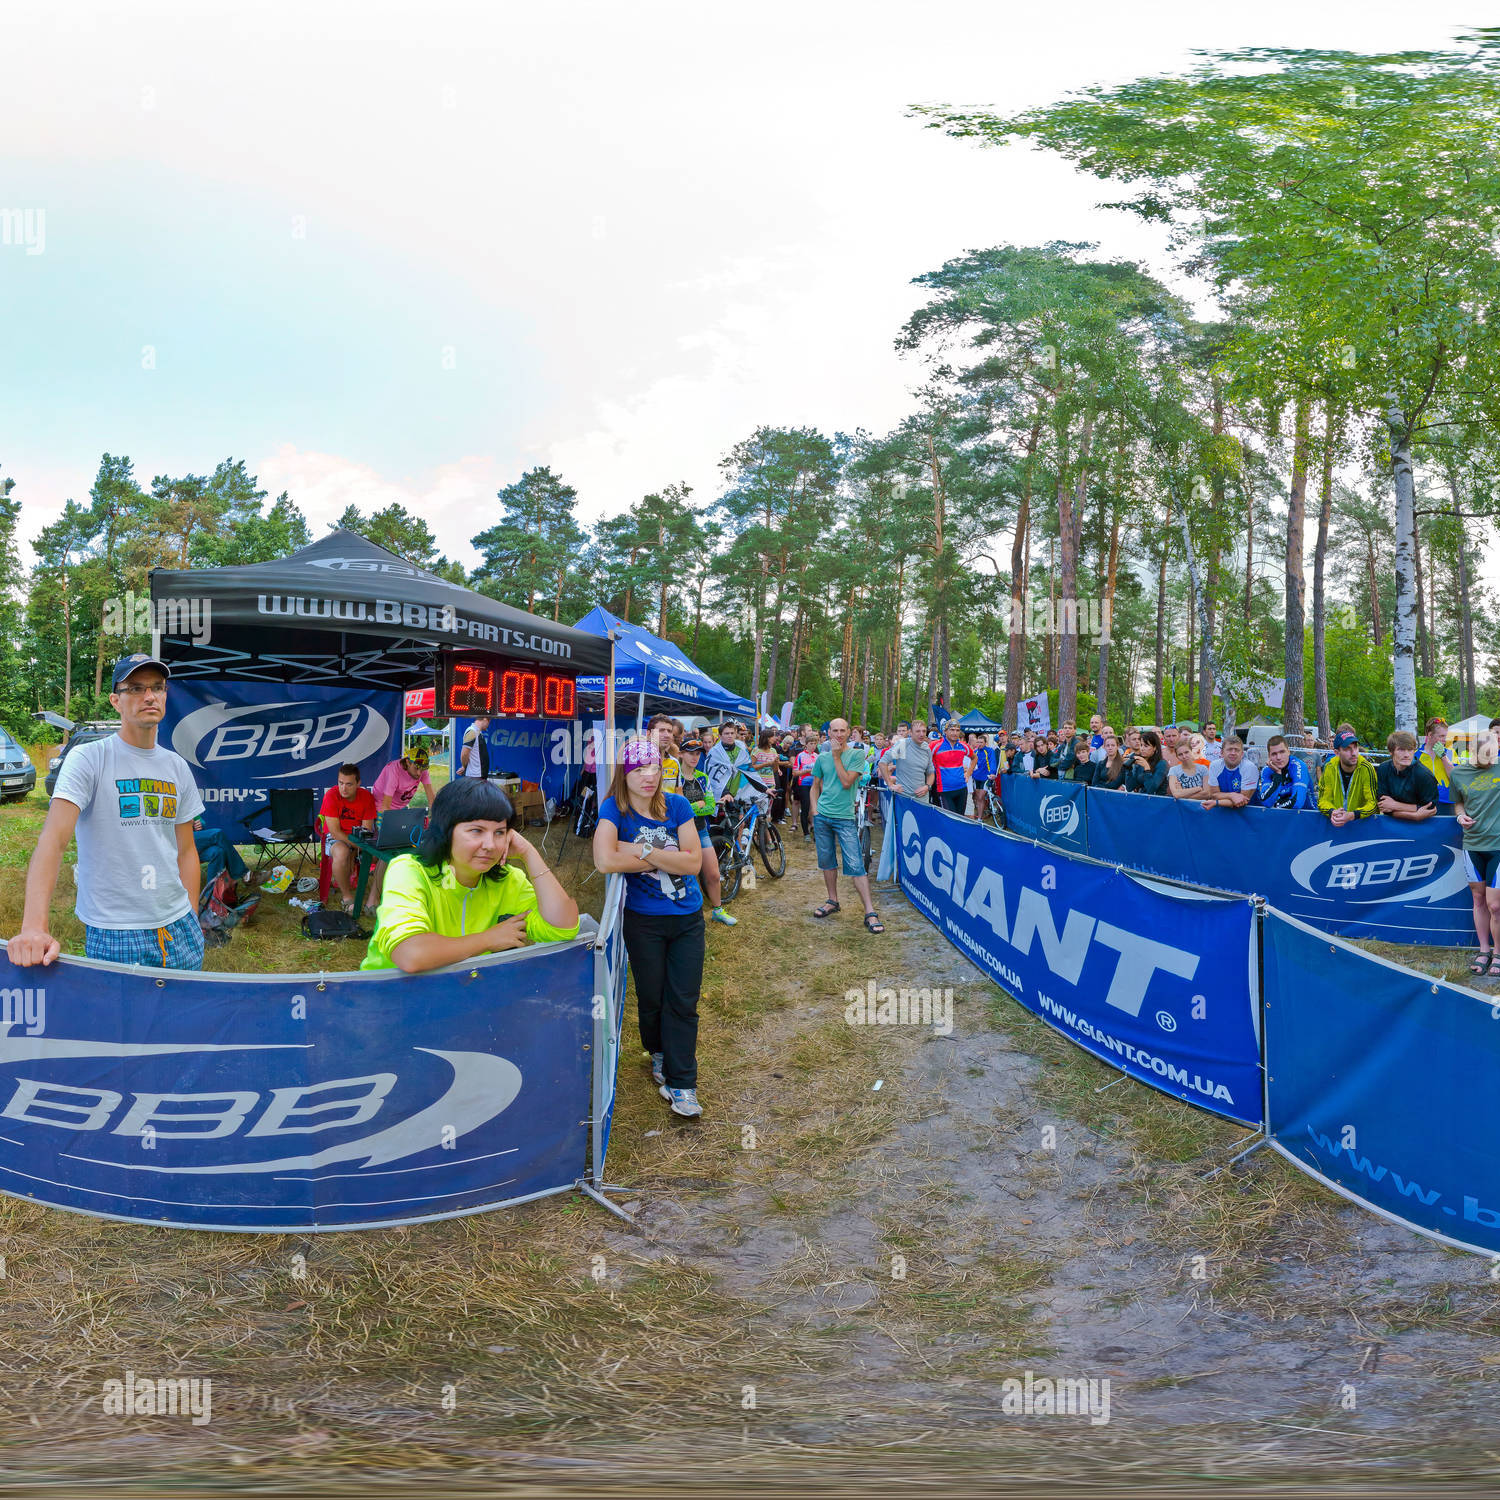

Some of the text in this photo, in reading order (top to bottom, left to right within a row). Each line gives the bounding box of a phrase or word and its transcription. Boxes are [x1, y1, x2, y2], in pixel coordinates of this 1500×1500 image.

[667, 679, 699, 698] GIANT
[204, 708, 361, 761] BBB
[115, 778, 178, 797] TRIATMAN
[1046, 805, 1071, 824] BBB
[1326, 852, 1440, 889] BBB
[925, 836, 1201, 1018] GIANT
[1037, 990, 1236, 1106] WWW.GIANT.COM.UA
[2, 1073, 398, 1140] BBB
